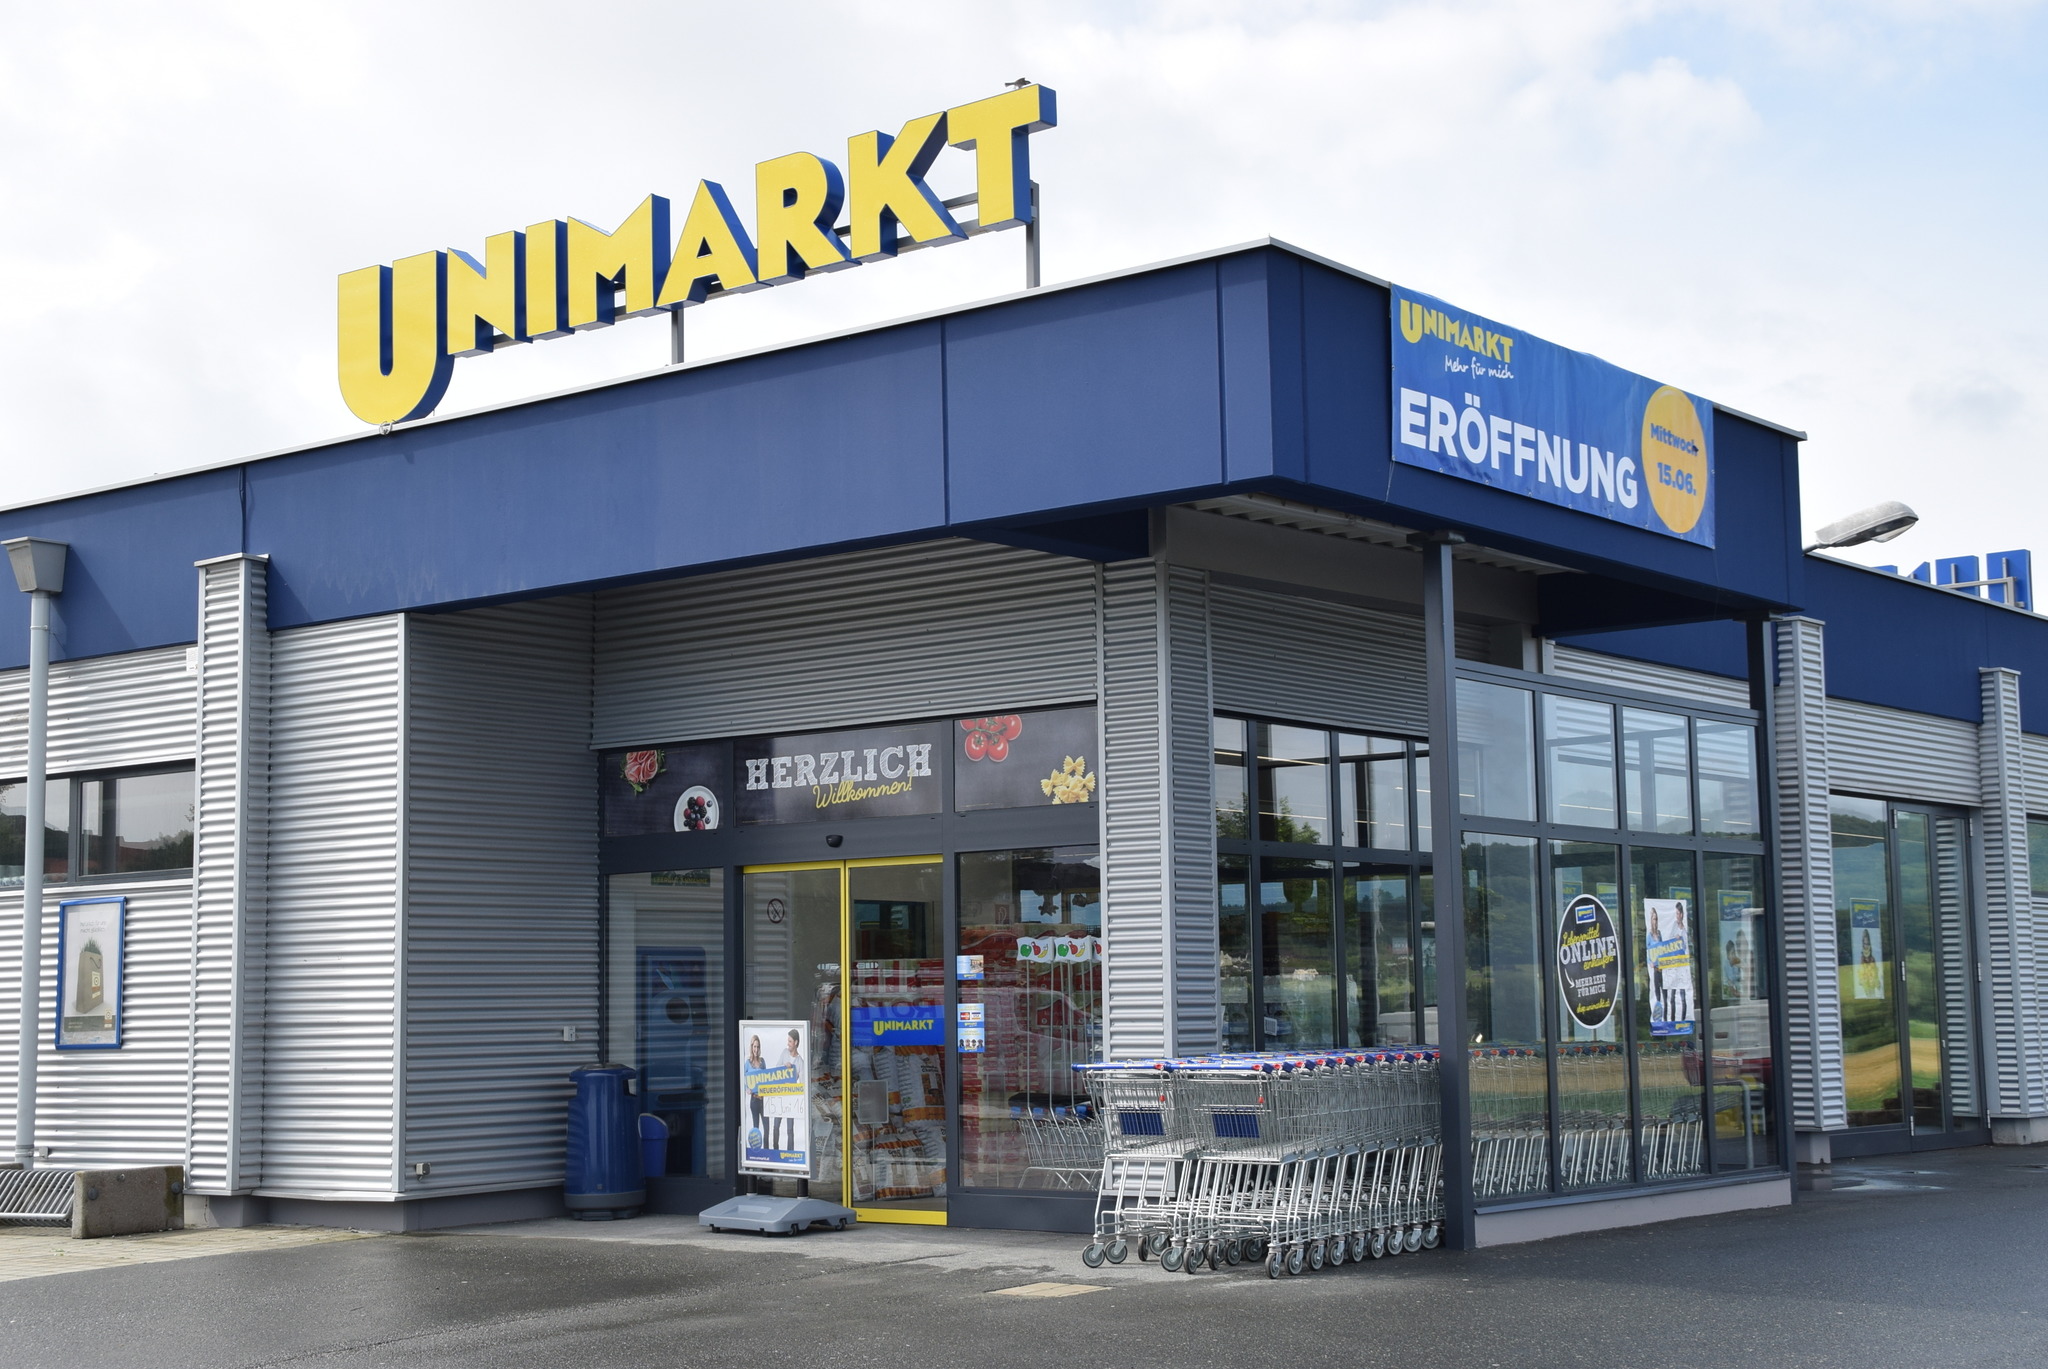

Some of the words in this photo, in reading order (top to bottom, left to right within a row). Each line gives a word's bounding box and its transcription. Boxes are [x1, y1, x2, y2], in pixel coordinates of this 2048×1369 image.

[338, 84, 1057, 426] UNIMARKT
[1400, 299, 1514, 363] UNIMARKT
[1445, 355, 1469, 373] Mehr
[1471, 356, 1486, 380] für
[1488, 364, 1515, 379] mich
[1400, 387, 1638, 509] ERÖFFNUNG
[1650, 423, 1699, 457] Mittwoch
[1657, 462, 1697, 496] 15.06.
[745, 744, 932, 791] HERZLICH
[813, 768, 913, 809] Willkommen!
[1560, 936, 1616, 965] ONLINE
[1575, 977, 1593, 988] MEHR
[1593, 974, 1606, 985] ZEIT
[1577, 986, 1590, 998] FÜR
[1590, 984, 1606, 995] MICH
[873, 1019, 934, 1036] UNIMARKT
[746, 1068, 794, 1090] UNIMARKT
[759, 1085, 804, 1094] NEUERÖFFNUNG
